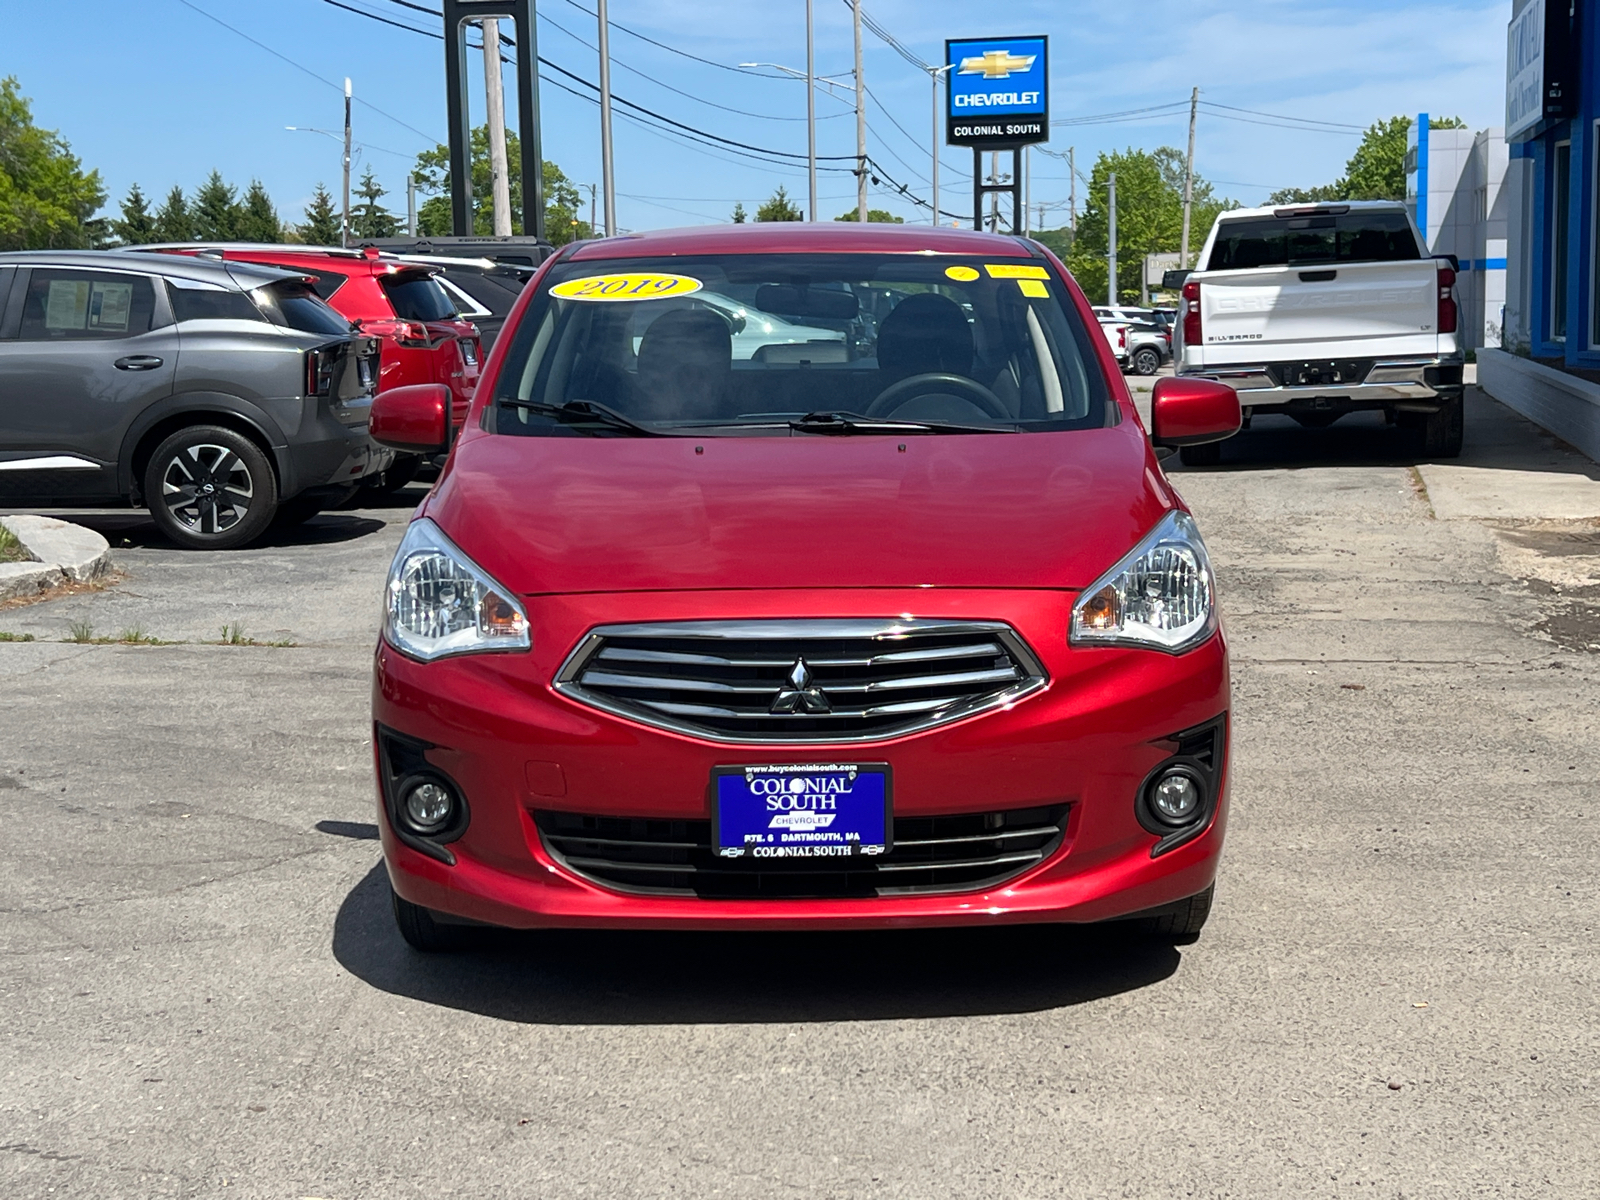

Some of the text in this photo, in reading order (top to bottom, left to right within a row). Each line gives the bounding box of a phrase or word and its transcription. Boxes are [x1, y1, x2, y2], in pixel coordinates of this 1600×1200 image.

[954, 91, 1040, 107] CHEVROLET
[954, 124, 1041, 136] COLONIAL SOUTH
[573, 278, 679, 296] 2019
[745, 764, 857, 773] www.buycolonialsouth.com
[750, 778, 852, 795] COLONIAL
[766, 794, 837, 811] SOUTH
[775, 816, 829, 825] CHEVROLET
[781, 832, 844, 842] DARTMOUTH,
[845, 832, 860, 841] MA
[753, 845, 852, 857] COLONIAL SOUTH
